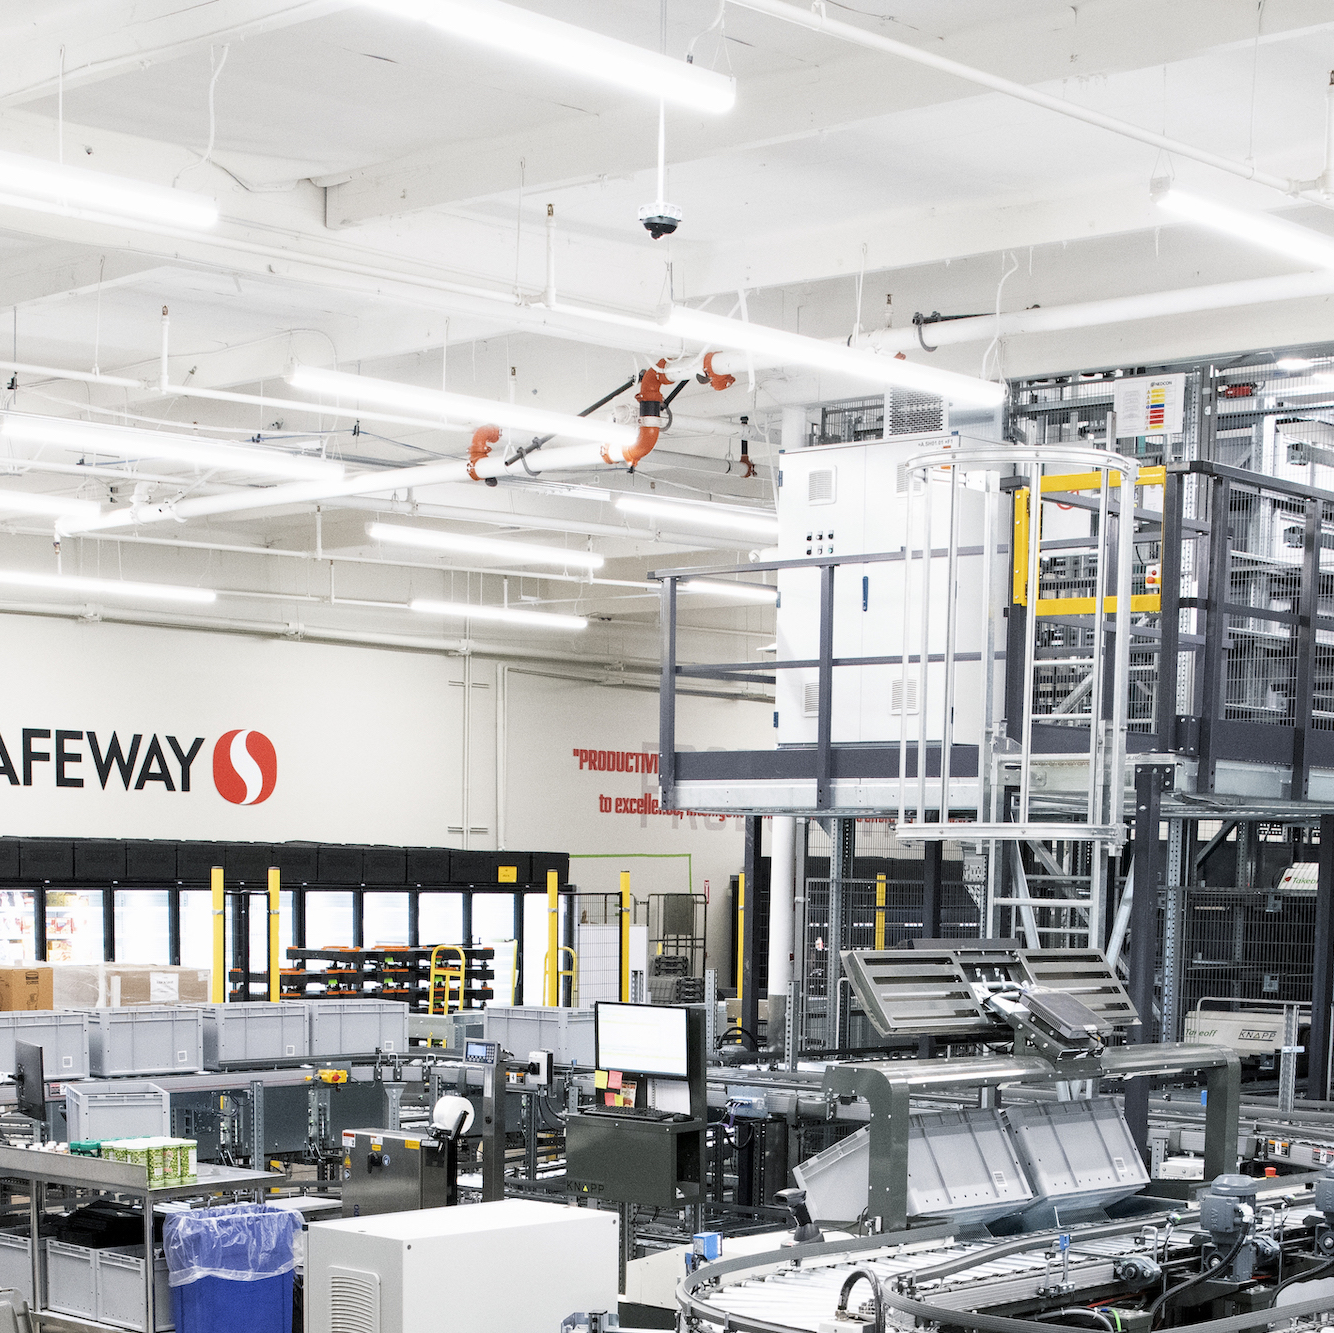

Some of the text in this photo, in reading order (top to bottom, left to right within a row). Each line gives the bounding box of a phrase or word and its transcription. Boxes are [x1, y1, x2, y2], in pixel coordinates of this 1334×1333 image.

[573, 748, 660, 774] "PRODUCTIVI
[599, 794, 612, 813] to
[1293, 876, 1318, 885] Takeo
[1238, 1031, 1277, 1039] KNAPP
[567, 1181, 605, 1193] KNAPP
